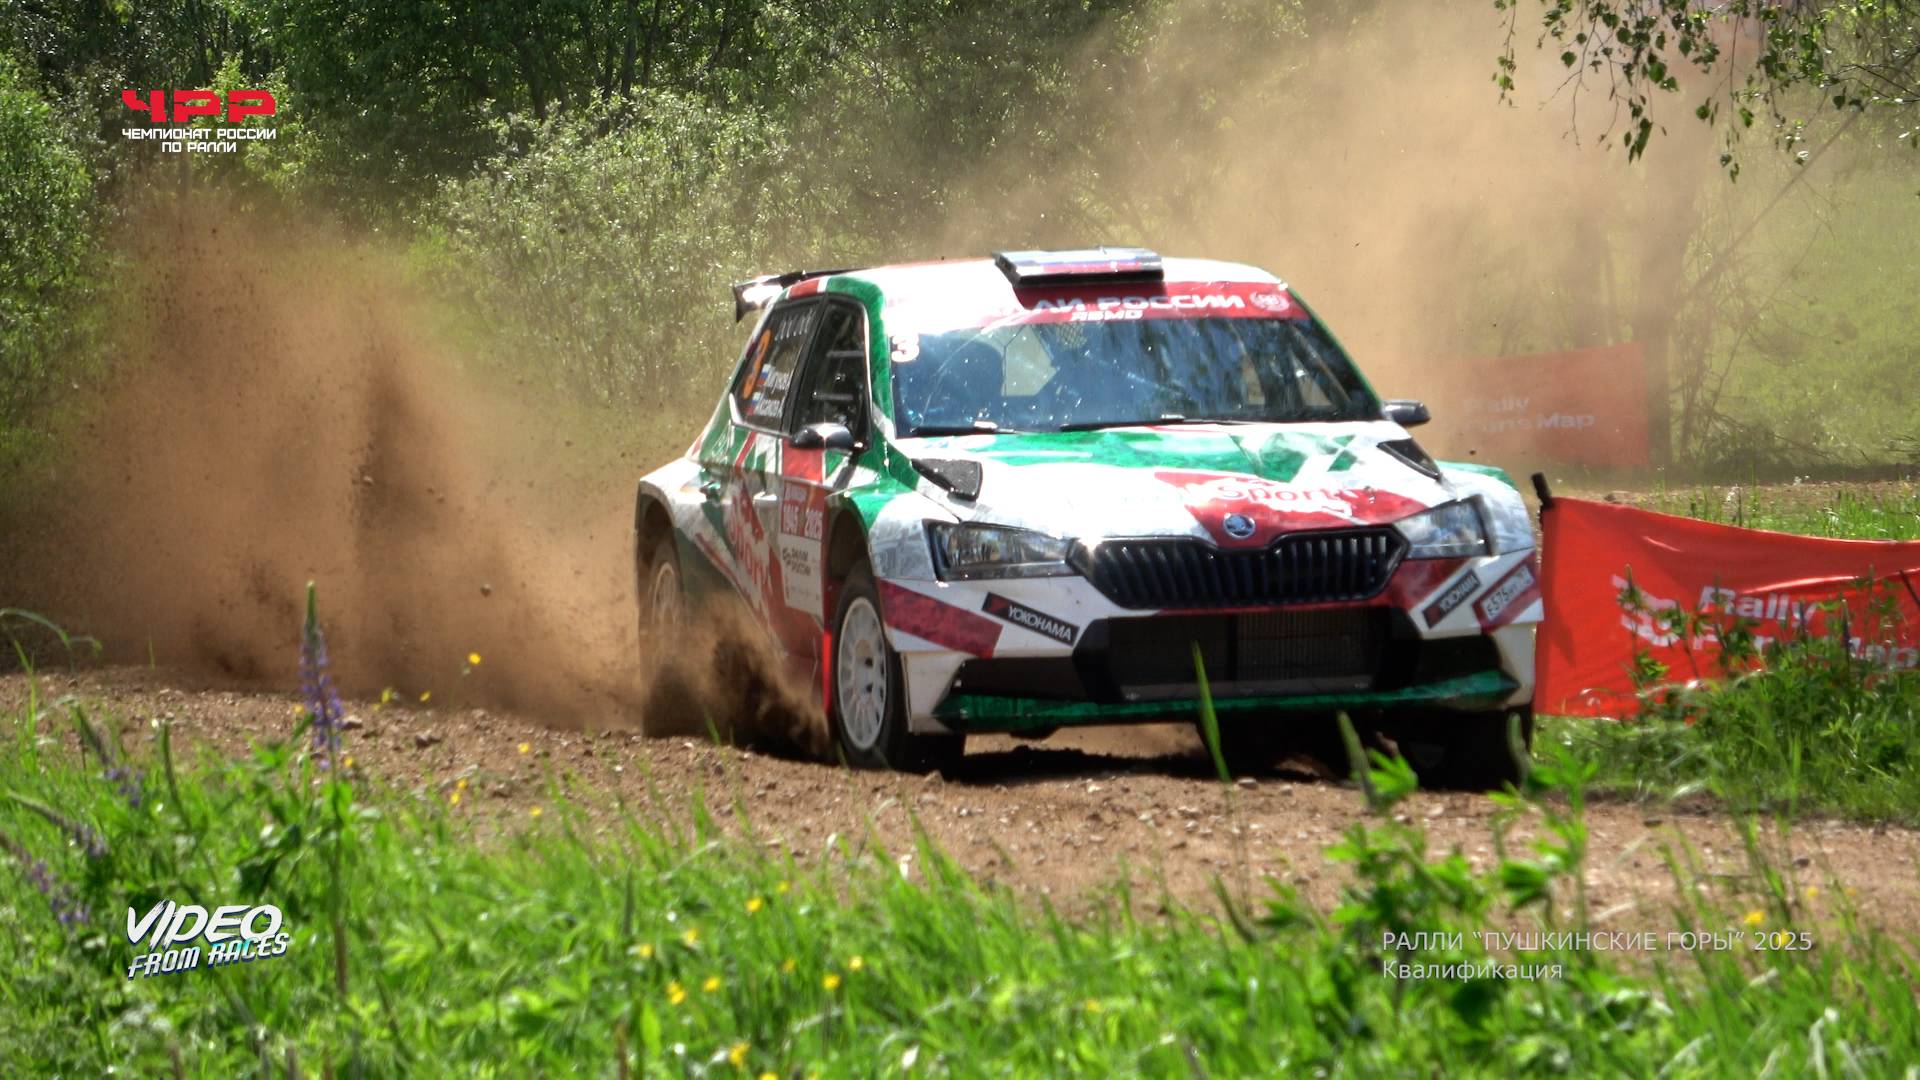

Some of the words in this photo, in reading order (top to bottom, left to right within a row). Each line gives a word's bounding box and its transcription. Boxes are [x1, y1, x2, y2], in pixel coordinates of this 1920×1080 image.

[1097, 294, 1246, 312] РОССИИ
[891, 330, 920, 363] 3
[1536, 411, 1596, 432] Map
[1008, 605, 1073, 641] YOKOHAMA
[1697, 586, 1817, 629] Rally
